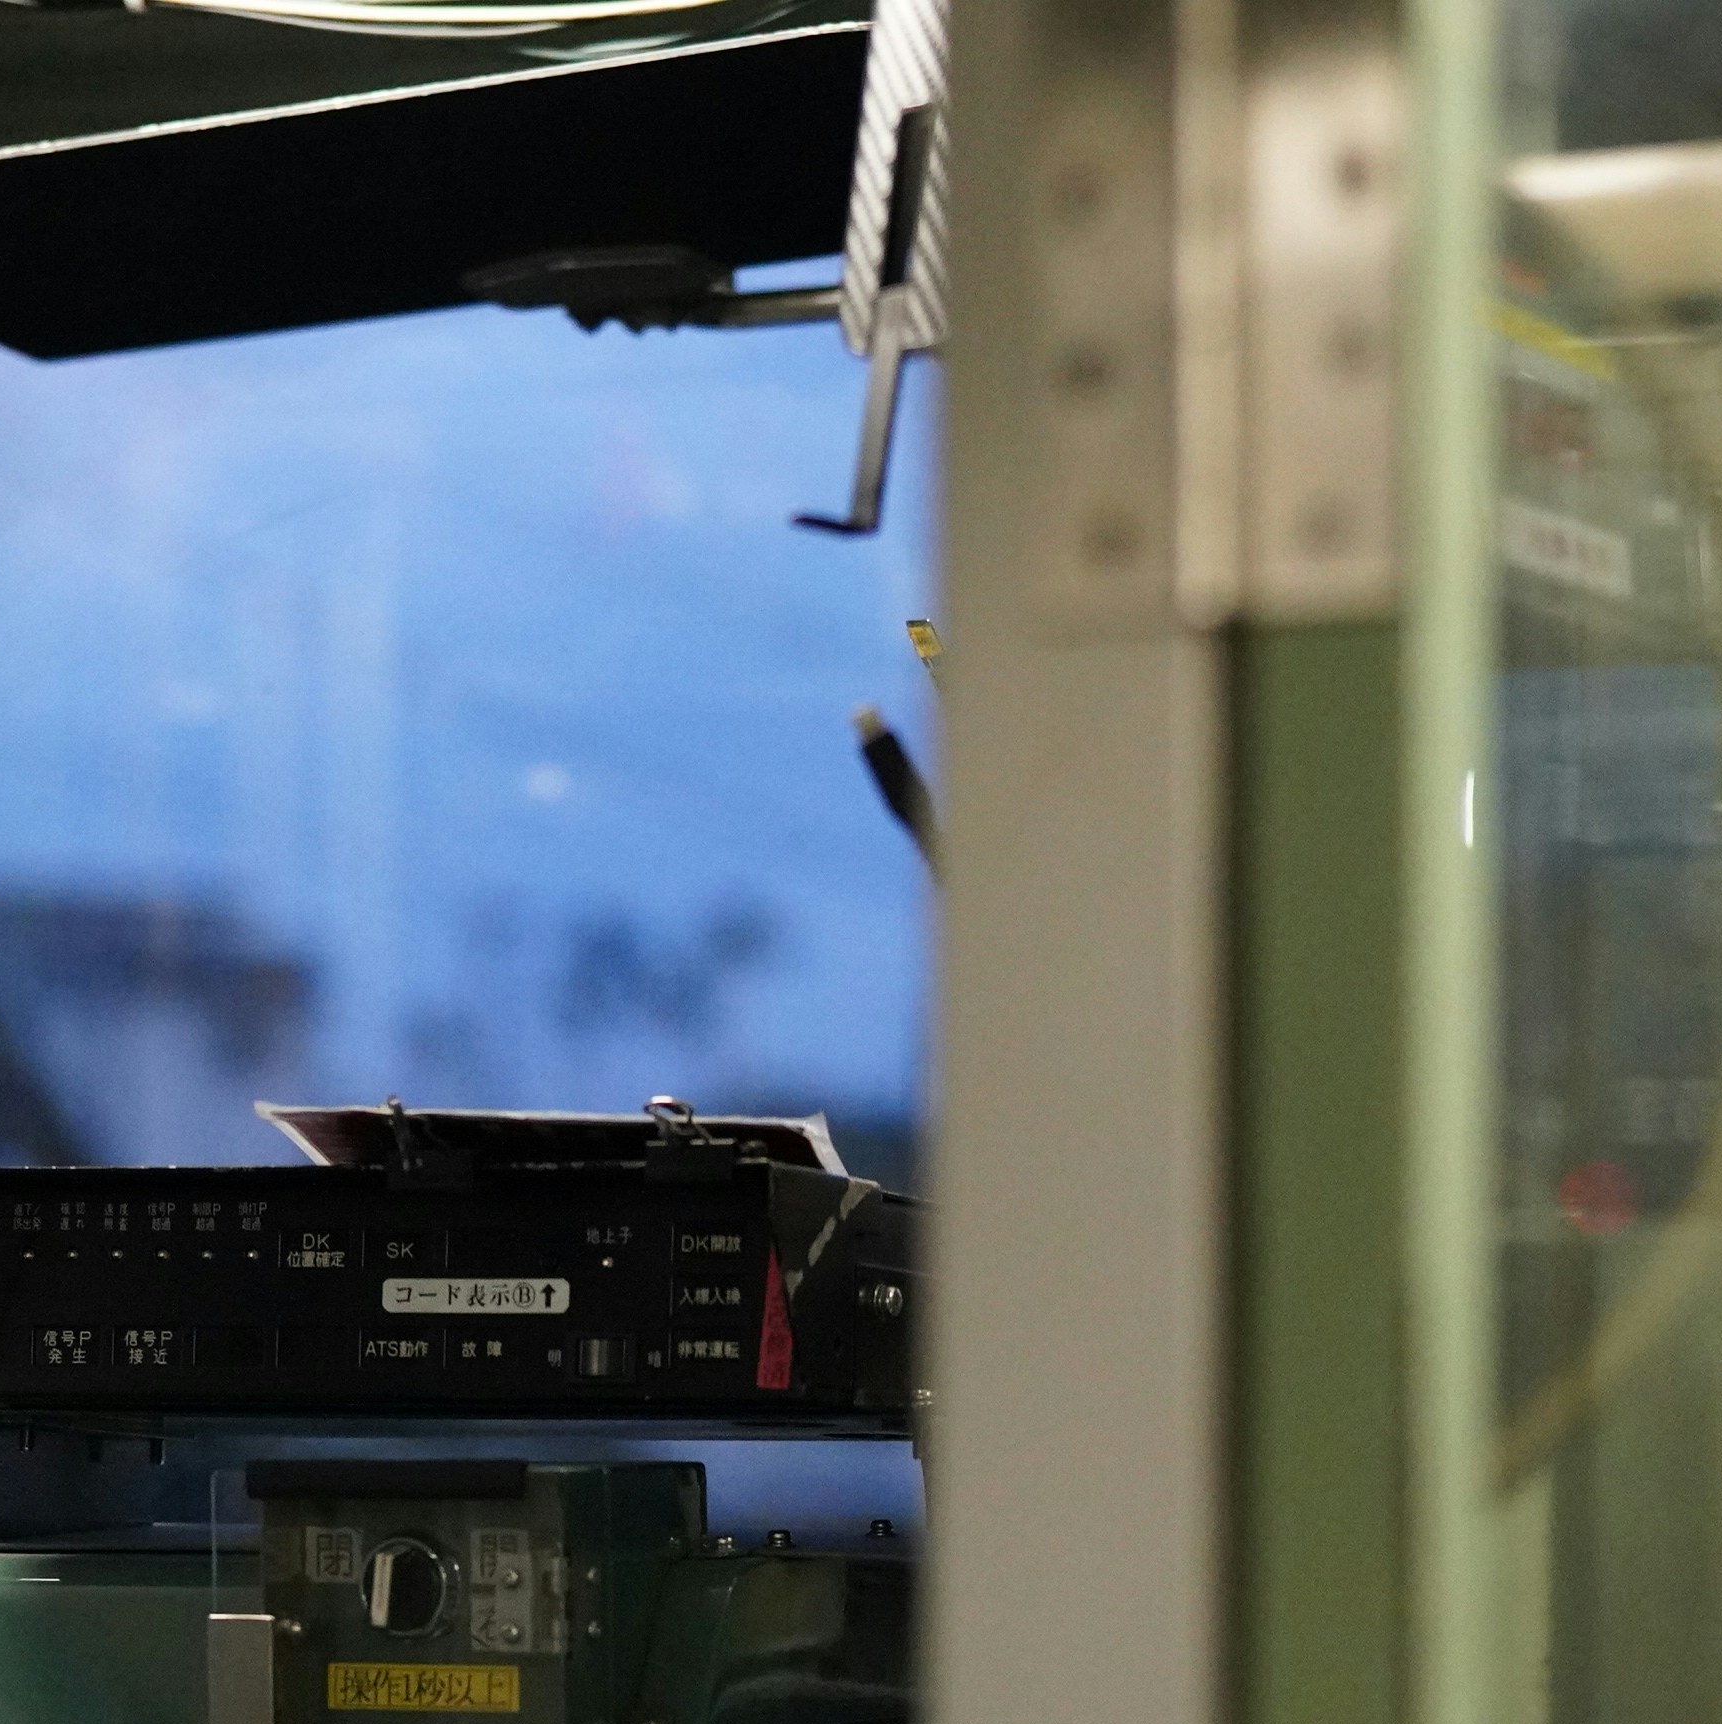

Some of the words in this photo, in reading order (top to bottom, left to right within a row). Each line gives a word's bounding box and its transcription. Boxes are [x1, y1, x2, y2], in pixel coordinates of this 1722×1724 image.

[302, 1232, 331, 1251] DK
[585, 1226, 633, 1246] 地上子
[385, 1241, 415, 1259] SK
[42, 1330, 93, 1348] 信号P
[123, 1330, 174, 1348] 信号P
[47, 1348, 88, 1365] 発生
[128, 1348, 169, 1365] 接近
[339, 1667, 506, 1707] 操作1秒以上
